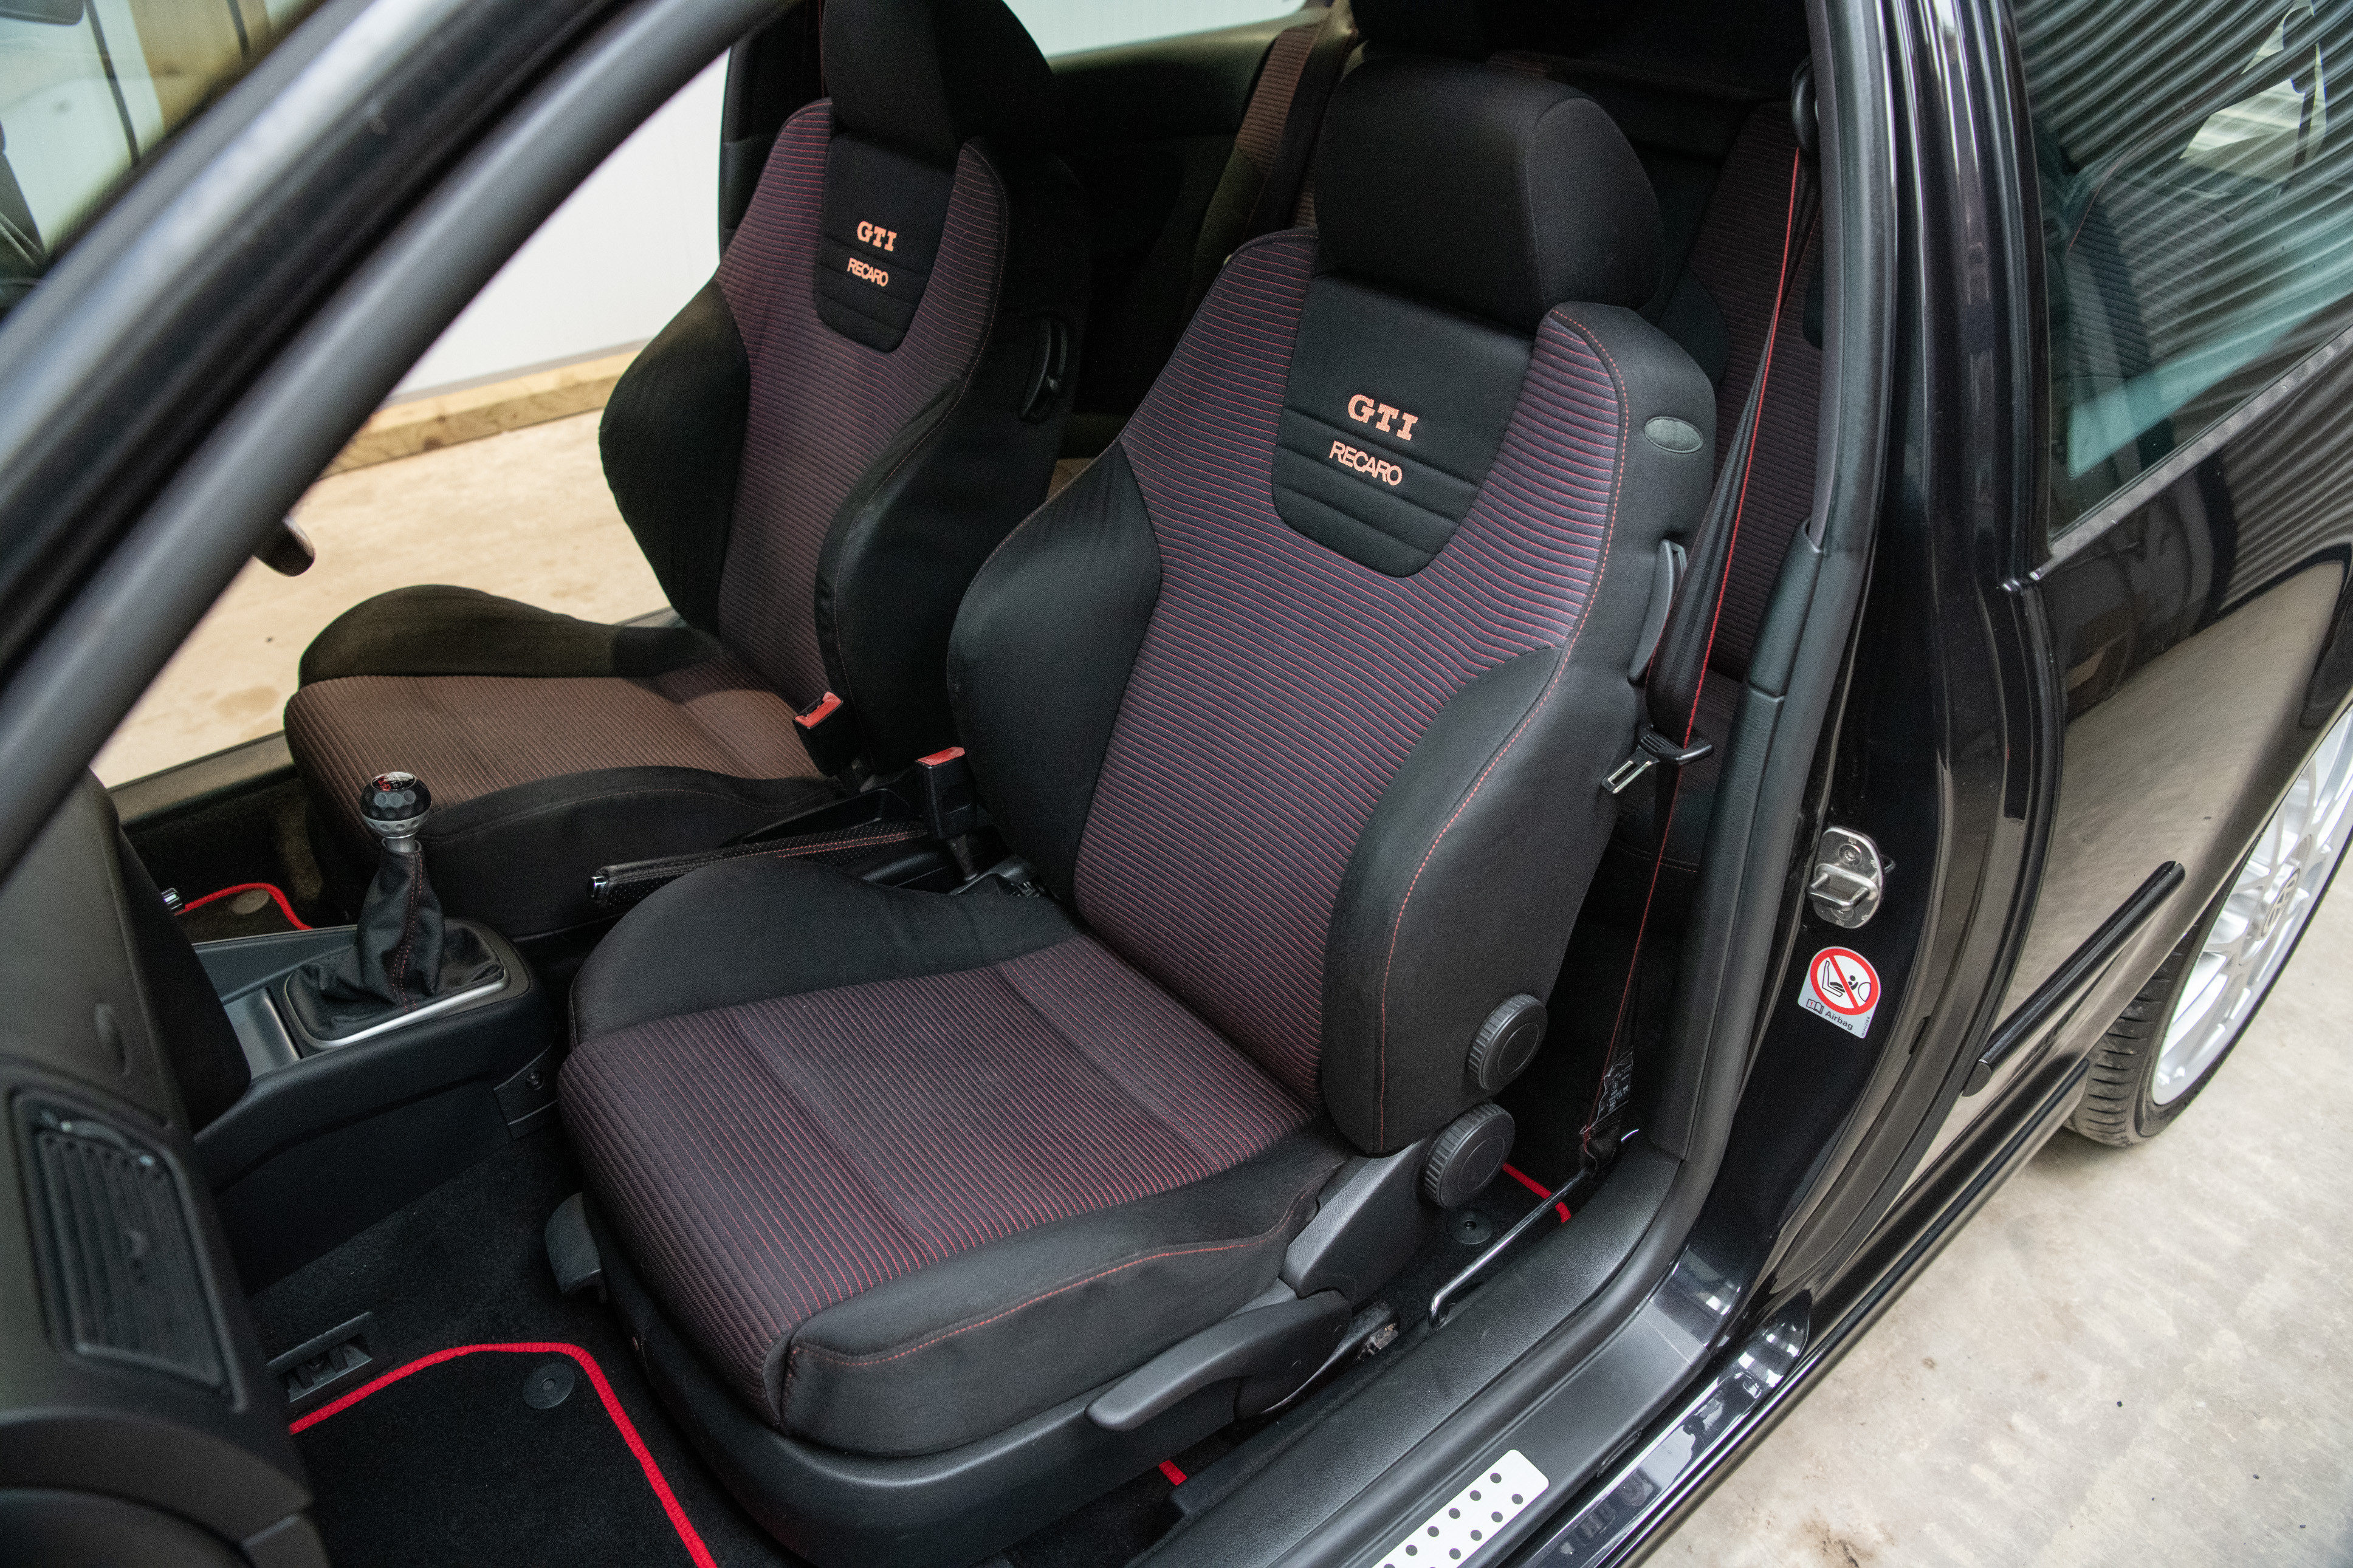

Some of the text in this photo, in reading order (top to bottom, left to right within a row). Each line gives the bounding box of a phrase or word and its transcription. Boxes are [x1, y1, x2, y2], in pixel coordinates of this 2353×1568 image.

[857, 221, 897, 252] GTI
[847, 257, 889, 287] RECARO
[1348, 394, 1418, 441] GTI
[1329, 440, 1403, 486] RECARO
[1825, 1011, 1853, 1031] Airbag
